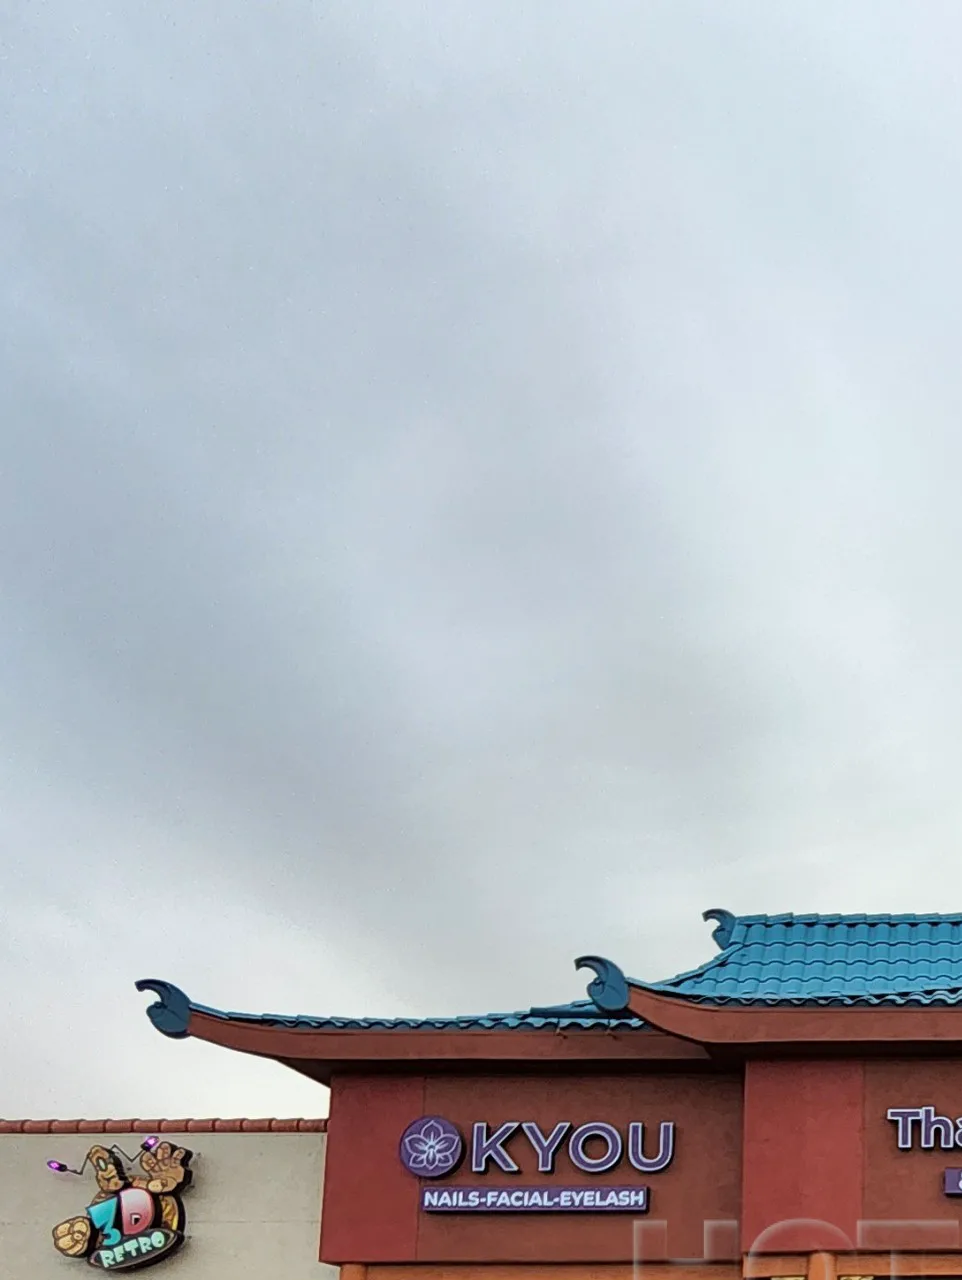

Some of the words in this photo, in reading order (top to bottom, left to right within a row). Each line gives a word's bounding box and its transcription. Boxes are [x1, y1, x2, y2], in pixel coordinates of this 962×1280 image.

[472, 1121, 675, 1172] KYOU
[85, 1187, 156, 1246] 3D
[423, 1190, 645, 1208] NAILS-FACIAL-EYELASH
[99, 1231, 165, 1269] RETRO
